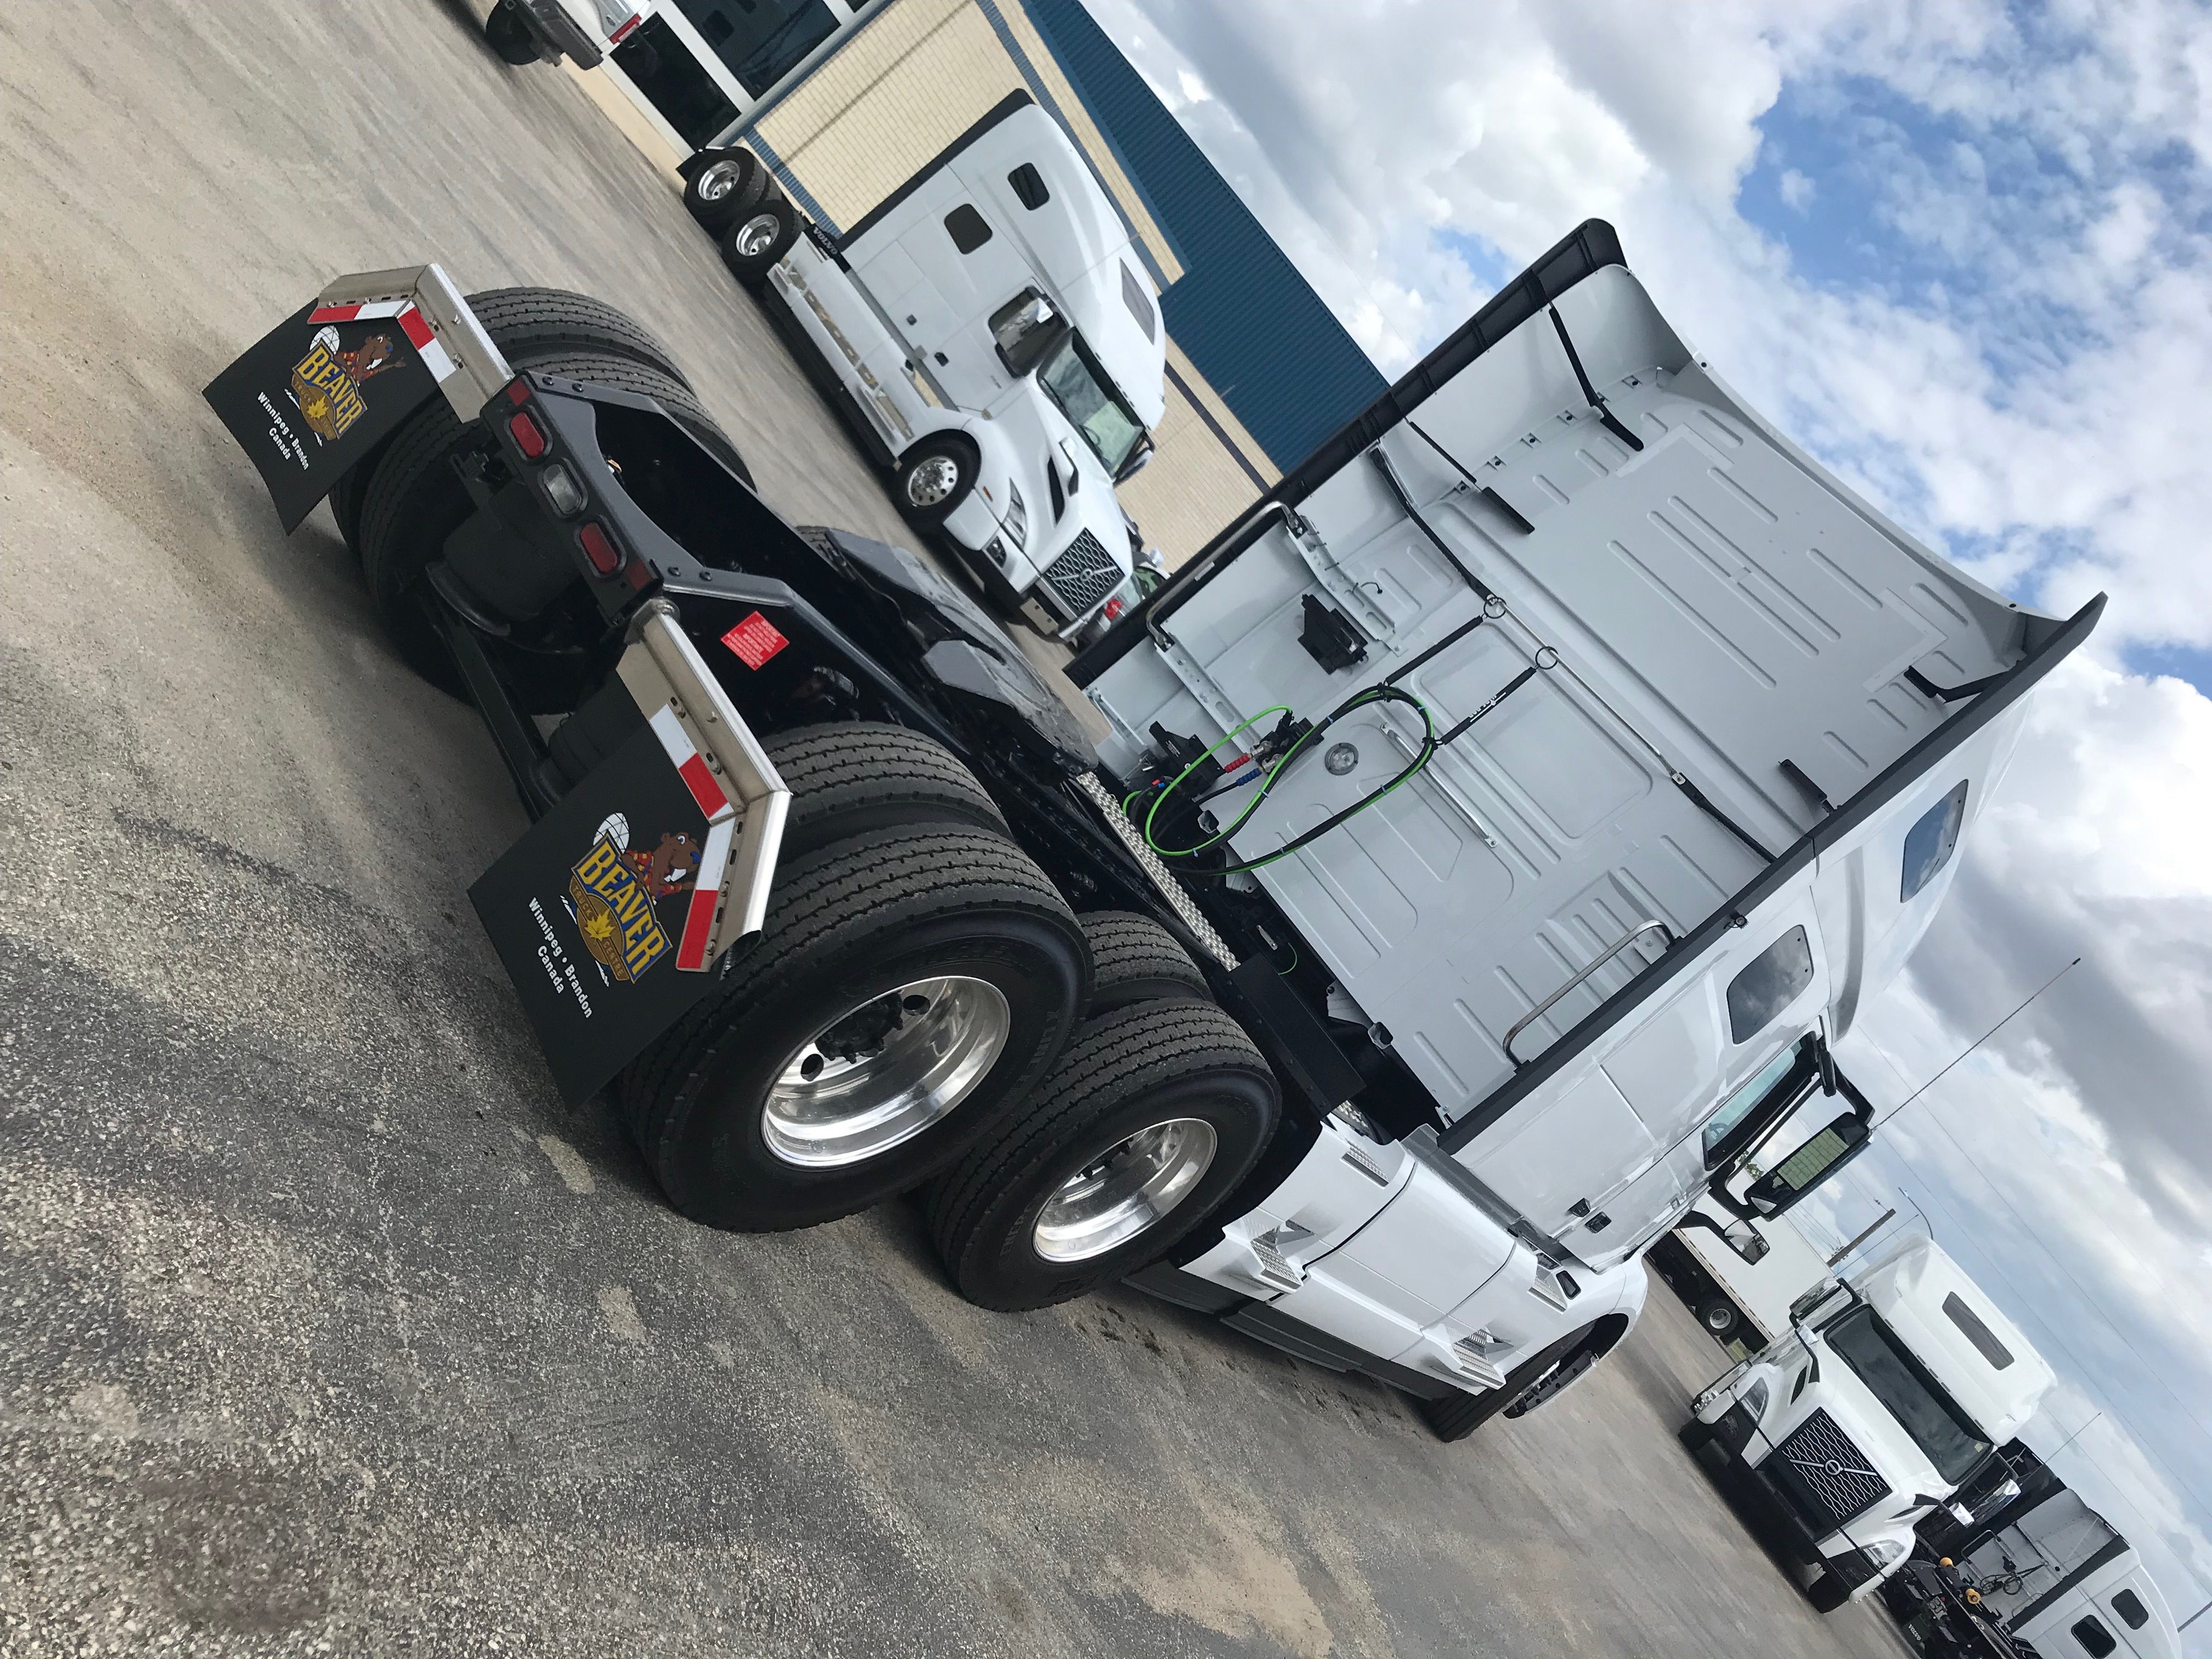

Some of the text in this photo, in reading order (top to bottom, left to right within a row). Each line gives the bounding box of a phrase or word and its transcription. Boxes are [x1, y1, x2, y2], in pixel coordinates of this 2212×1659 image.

[813, 226, 838, 255] VOLVO
[297, 346, 363, 434] BEAVER
[257, 392, 309, 470] Winnipeg Brandon
[269, 427, 291, 460] Canada
[572, 885, 624, 977] TRUCK CENTRE
[577, 841, 665, 975] BEAVER
[528, 897, 592, 1019] Winnipeg Brandon
[538, 945, 565, 994] Canada
[1909, 1624, 1921, 1640] VOLVO
